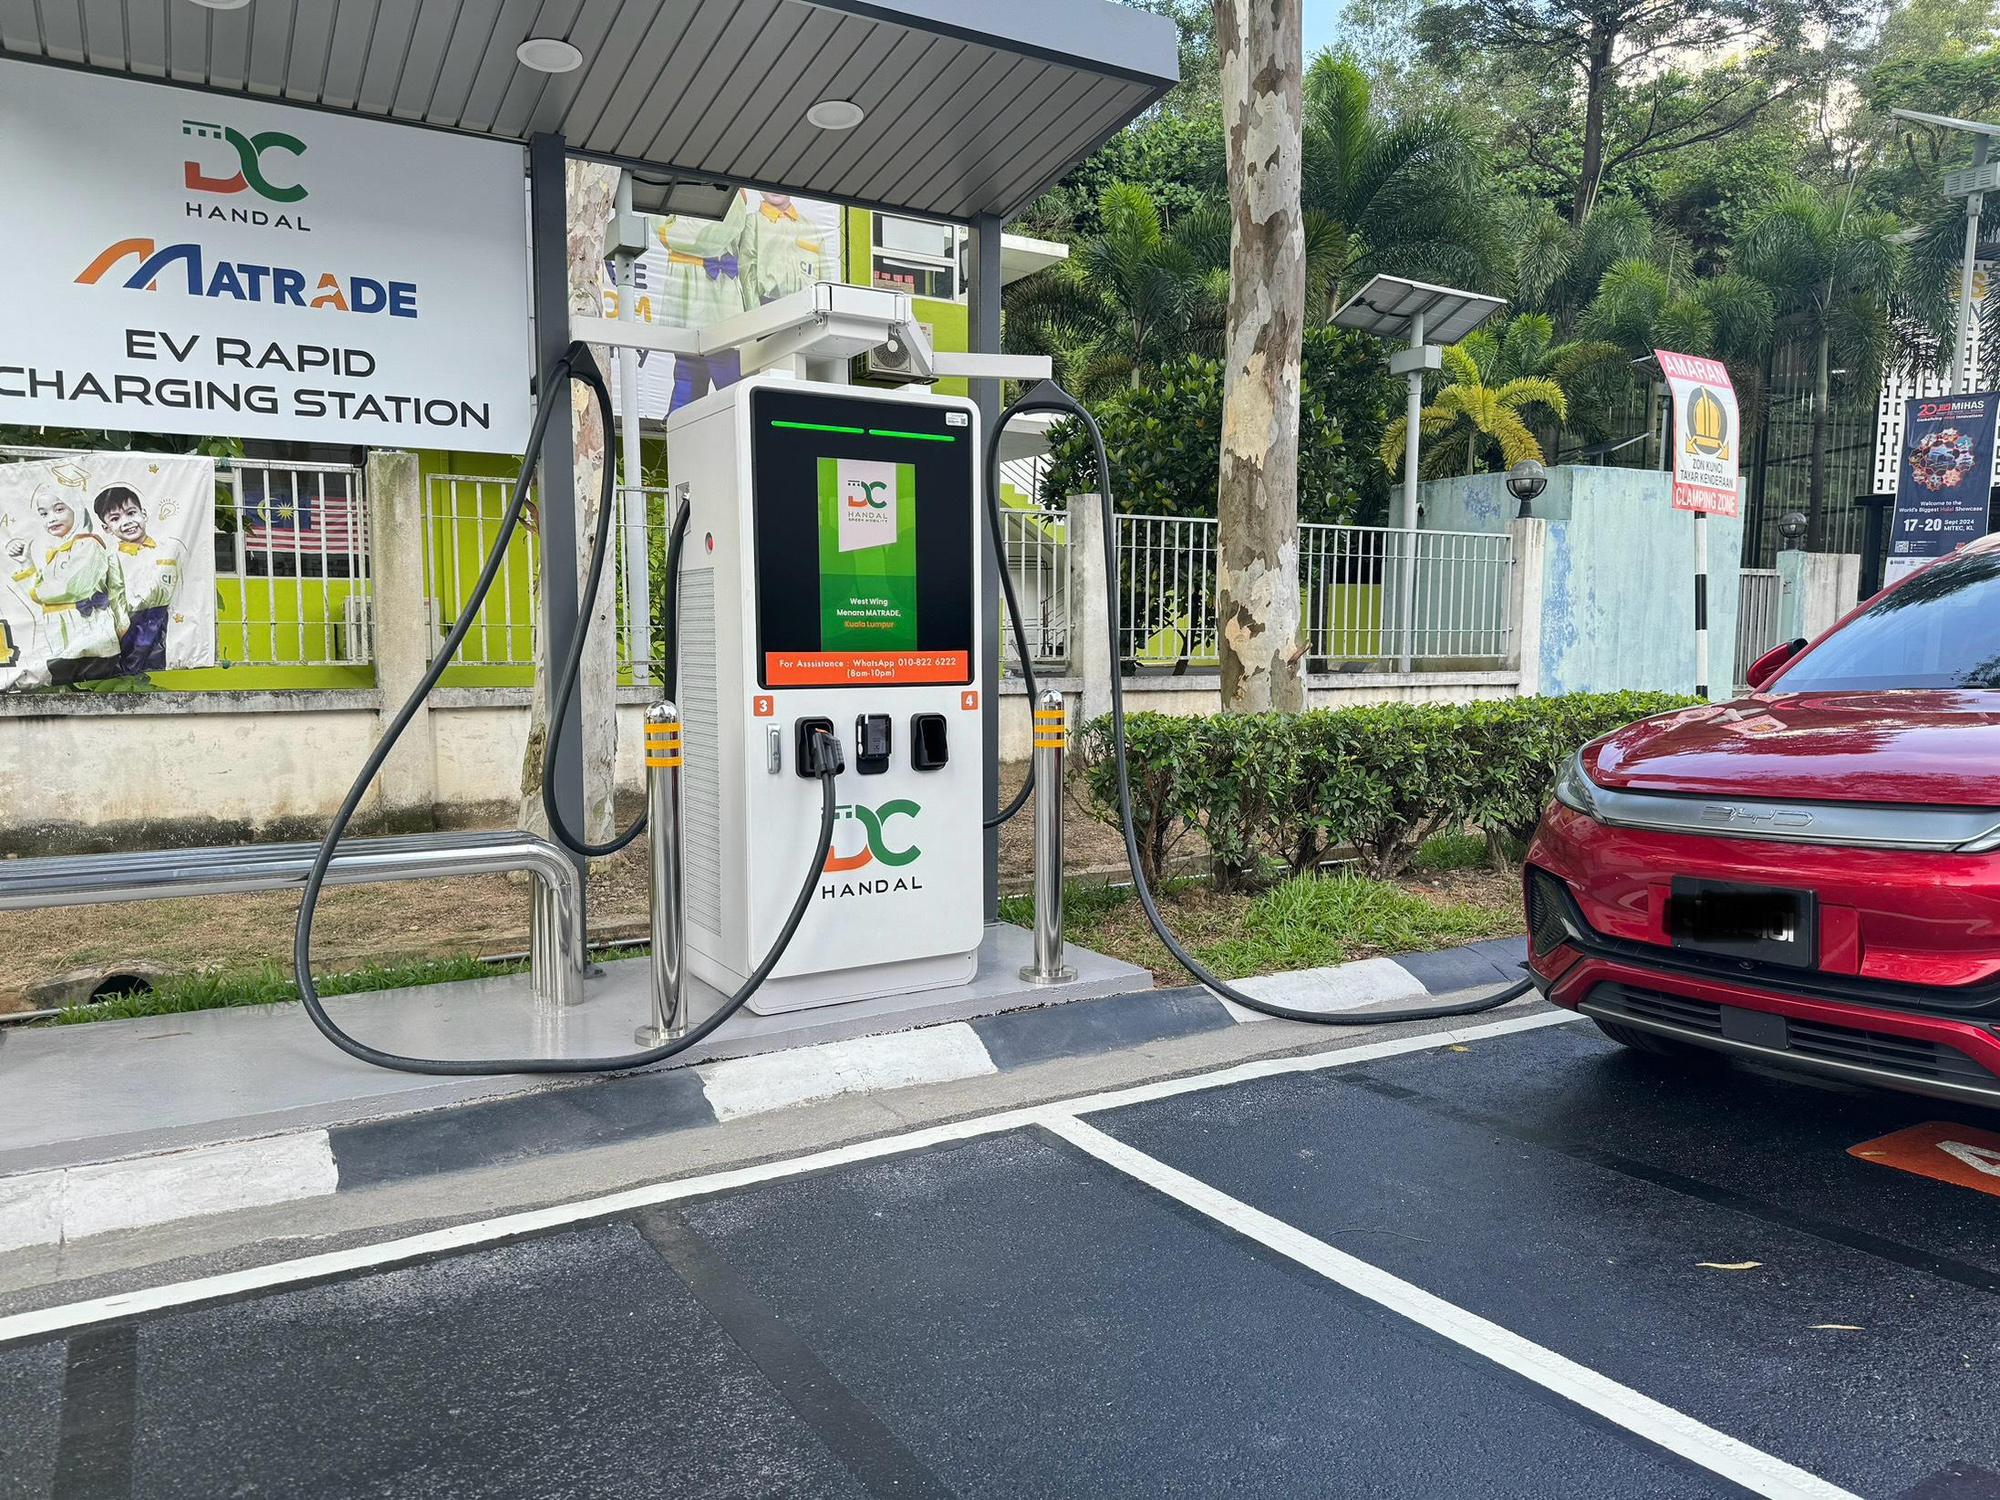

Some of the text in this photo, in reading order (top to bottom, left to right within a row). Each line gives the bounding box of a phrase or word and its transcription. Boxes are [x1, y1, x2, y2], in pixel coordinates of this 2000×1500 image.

[186, 202, 311, 232] HANDAL
[73, 238, 418, 319] MATRADE
[126, 328, 376, 378] EV RAPID
[1664, 355, 1729, 385] AMARAN
[0, 366, 490, 430] CHARGING STATION
[1951, 400, 1985, 411] MIHAS
[1693, 458, 1723, 474] ZON KUNCI
[1680, 469, 1734, 489] TAYAR KENDERAAN
[1676, 487, 1736, 513] CLAMPING ZONE
[847, 511, 888, 519] HANDAL
[850, 597, 889, 607] West Wing
[836, 609, 865, 617] Menara
[844, 620, 895, 630] Kuala Lumpur
[779, 659, 794, 668] For
[853, 658, 895, 670] WhatsApp
[897, 657, 932, 667] 010-822
[935, 656, 957, 667] 6222
[847, 668, 896, 680] (8am-10pm)
[759, 699, 769, 714] 3
[964, 693, 974, 707] 4
[1701, 804, 1814, 827] BYD
[821, 876, 923, 900] HANDAL
